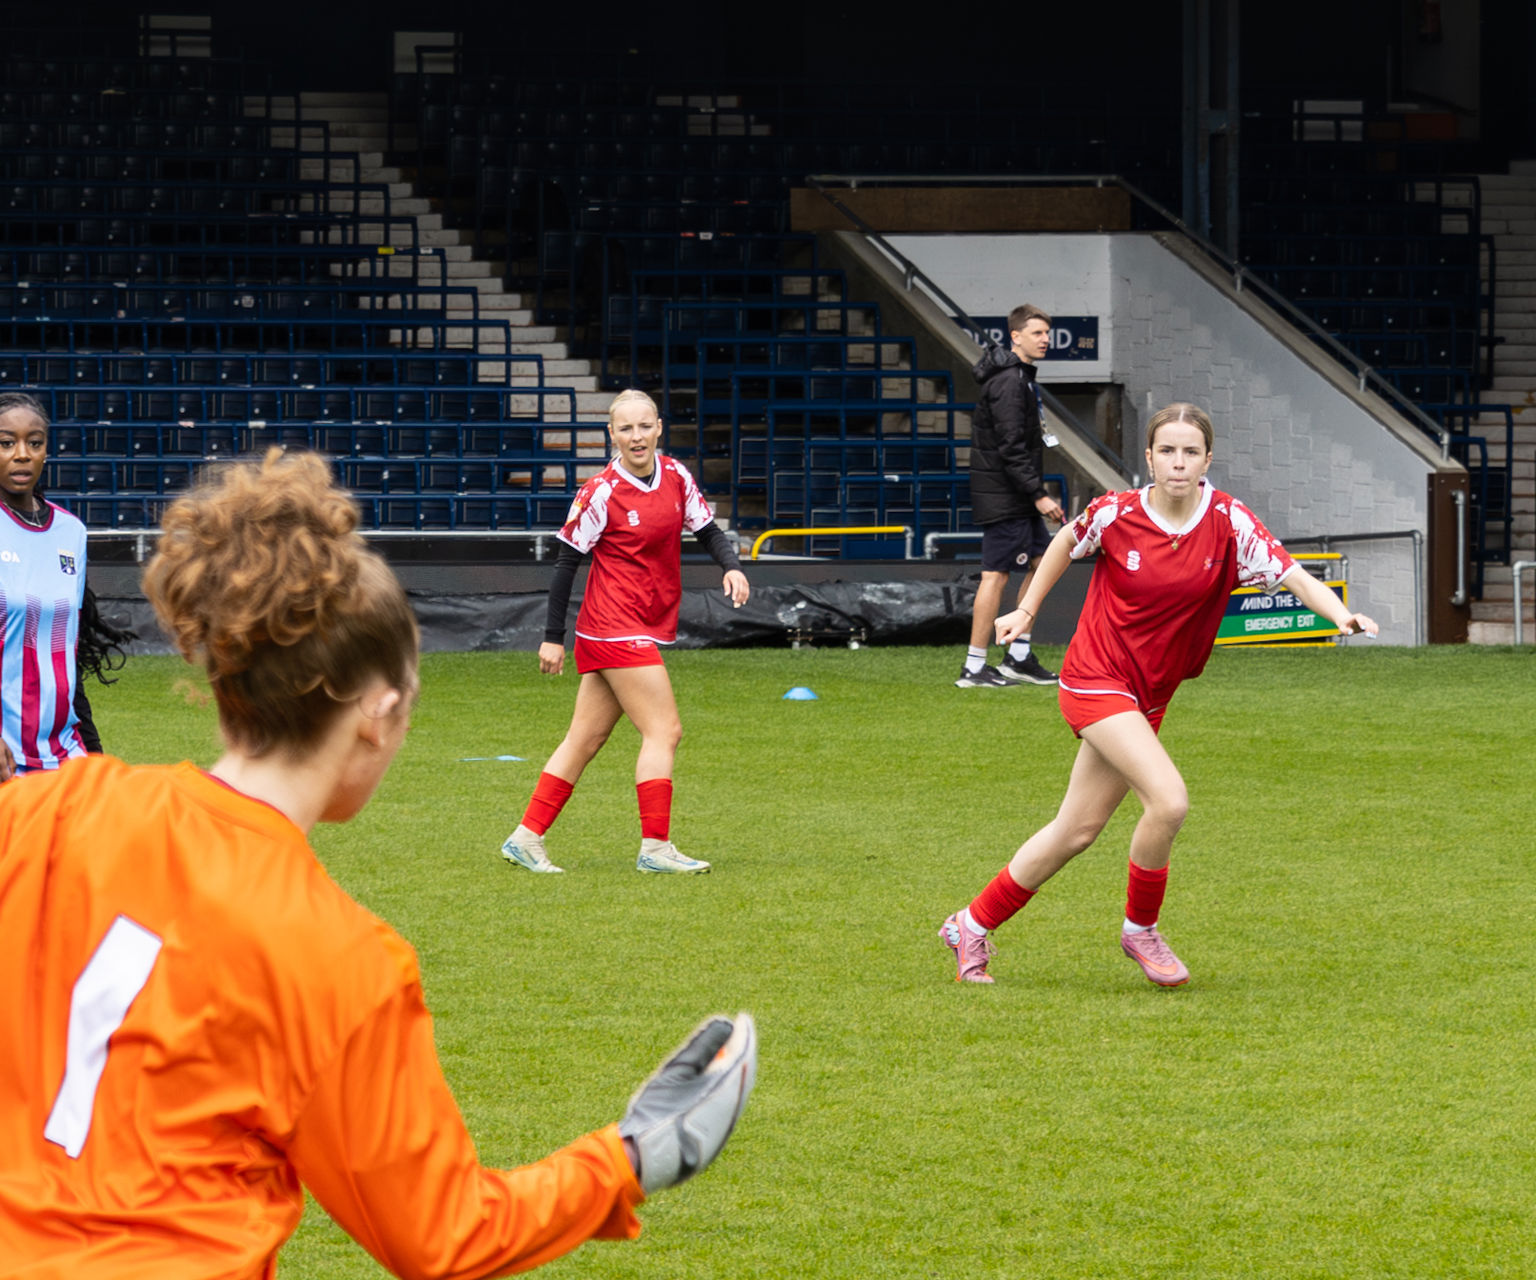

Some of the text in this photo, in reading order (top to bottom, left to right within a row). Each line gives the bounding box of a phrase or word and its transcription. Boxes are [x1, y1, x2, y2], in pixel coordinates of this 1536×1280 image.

[1240, 597, 1273, 610] MIND
[1275, 594, 1294, 608] THE
[1245, 614, 1315, 631] EMERGENCY EXIT
[44, 913, 162, 1159] 1
